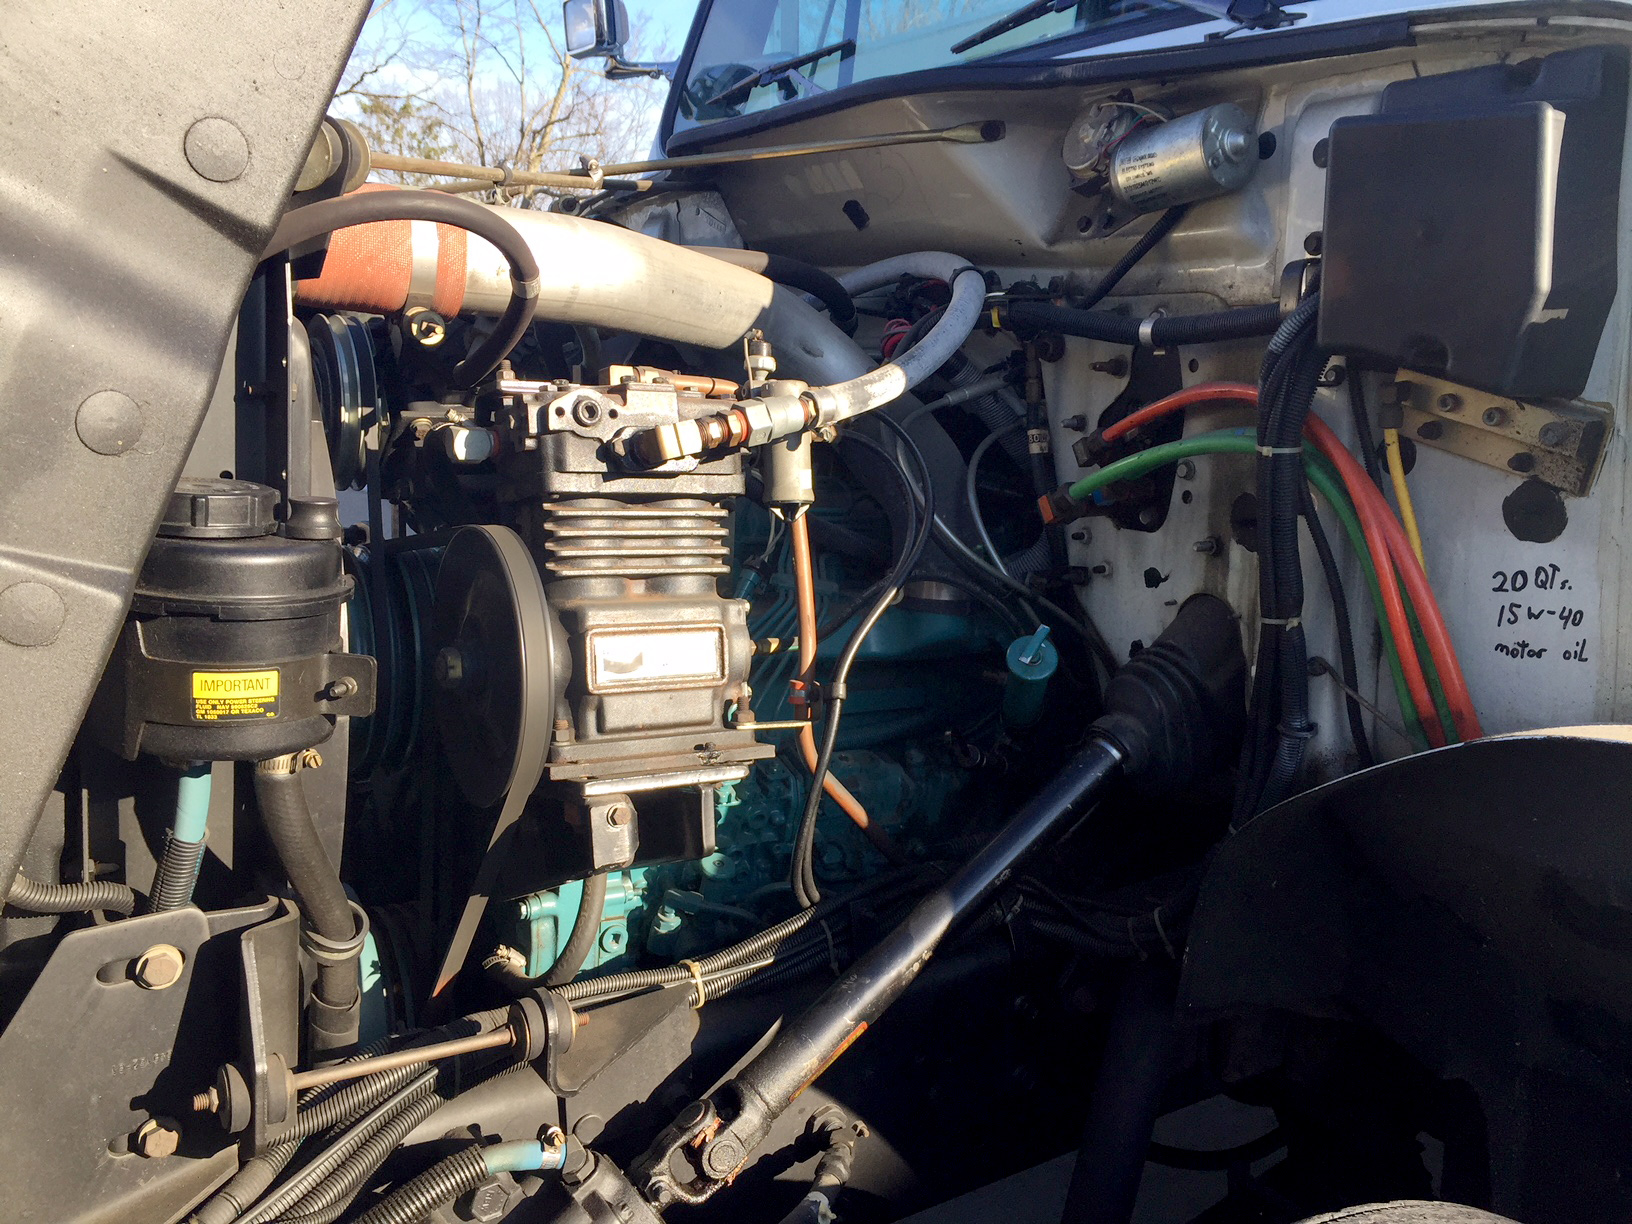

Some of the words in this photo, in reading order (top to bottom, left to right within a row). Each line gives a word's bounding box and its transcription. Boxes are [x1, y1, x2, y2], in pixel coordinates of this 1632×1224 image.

[1492, 569, 1528, 592] 20
[1494, 640, 1547, 659] motor
[200, 677, 271, 692] IMPORTANT
